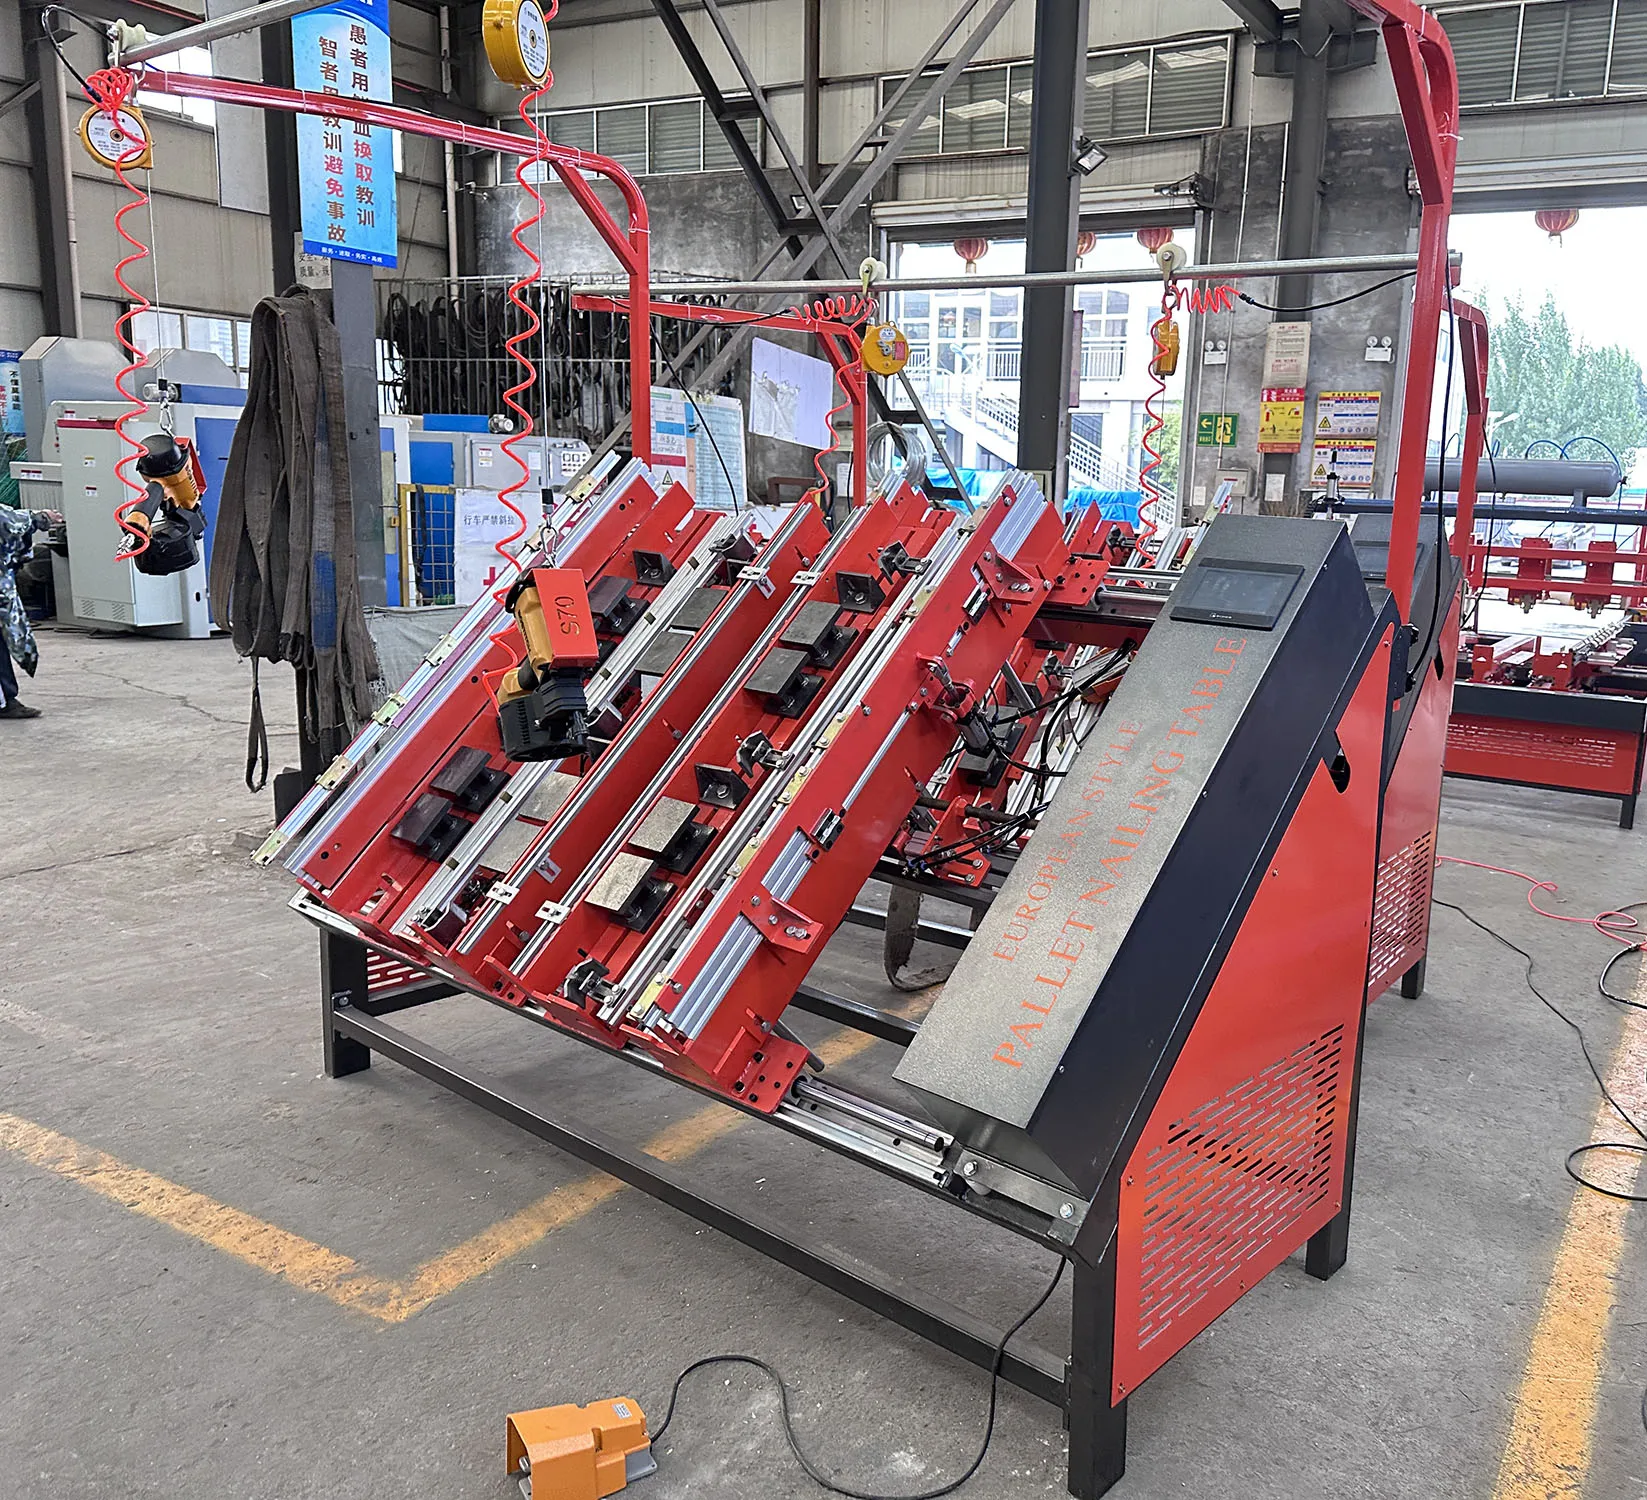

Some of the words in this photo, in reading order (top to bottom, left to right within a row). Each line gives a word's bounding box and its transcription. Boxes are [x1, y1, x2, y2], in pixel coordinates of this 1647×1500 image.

[350, 24, 375, 228] 愚者用血换取教训
[555, 596, 580, 635] S70
[991, 911, 1095, 1070] PALLET
[1078, 750, 1185, 906] NAILING
[1166, 637, 1247, 740] TABLE
[993, 808, 1093, 962] EUROPEAN
[1081, 720, 1143, 802] STYLE
